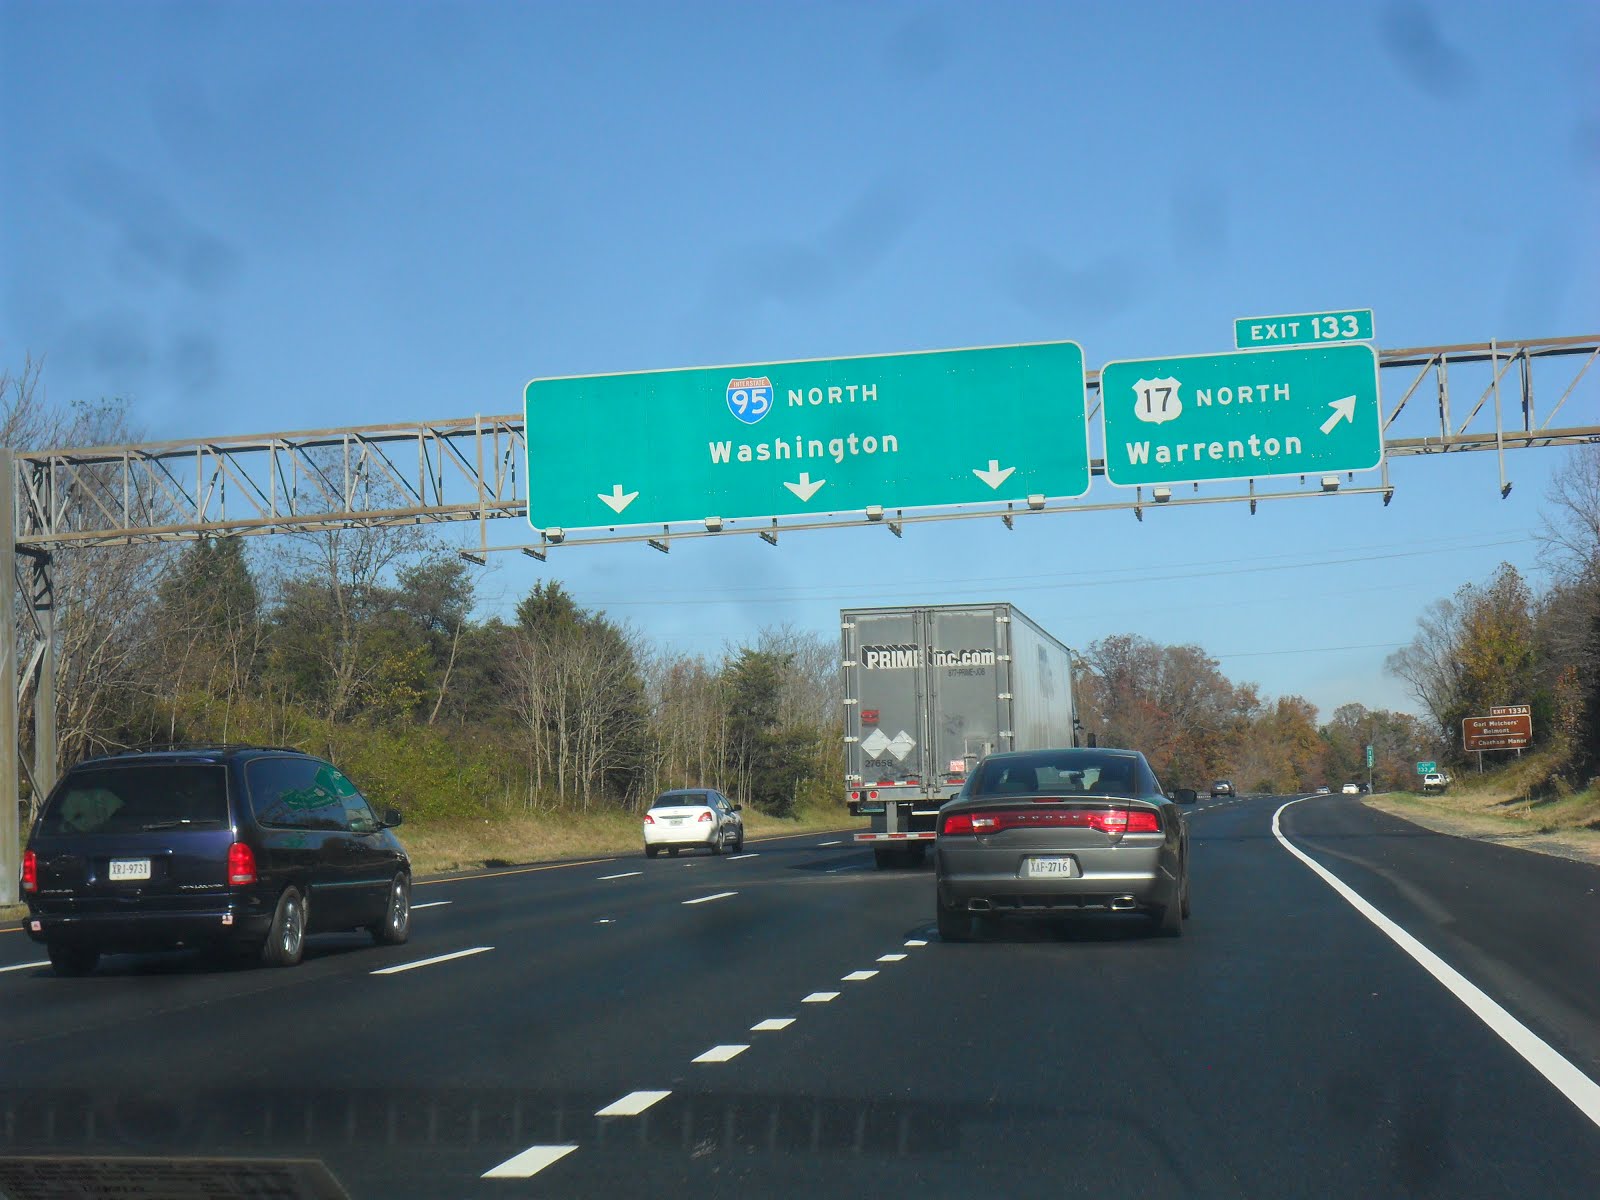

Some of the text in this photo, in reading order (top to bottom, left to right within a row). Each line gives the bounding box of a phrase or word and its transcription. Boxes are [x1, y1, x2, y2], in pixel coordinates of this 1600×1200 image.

[1251, 315, 1360, 341] EXIT 133
[733, 379, 765, 388] INTERSTATE
[731, 384, 878, 415] 95 NORTH
[1143, 383, 1291, 413] 17 NORTH
[708, 432, 899, 464] Washington
[1126, 433, 1303, 465] Warrenton
[864, 759, 893, 768] 27658
[111, 863, 148, 875] XRJ-9731
